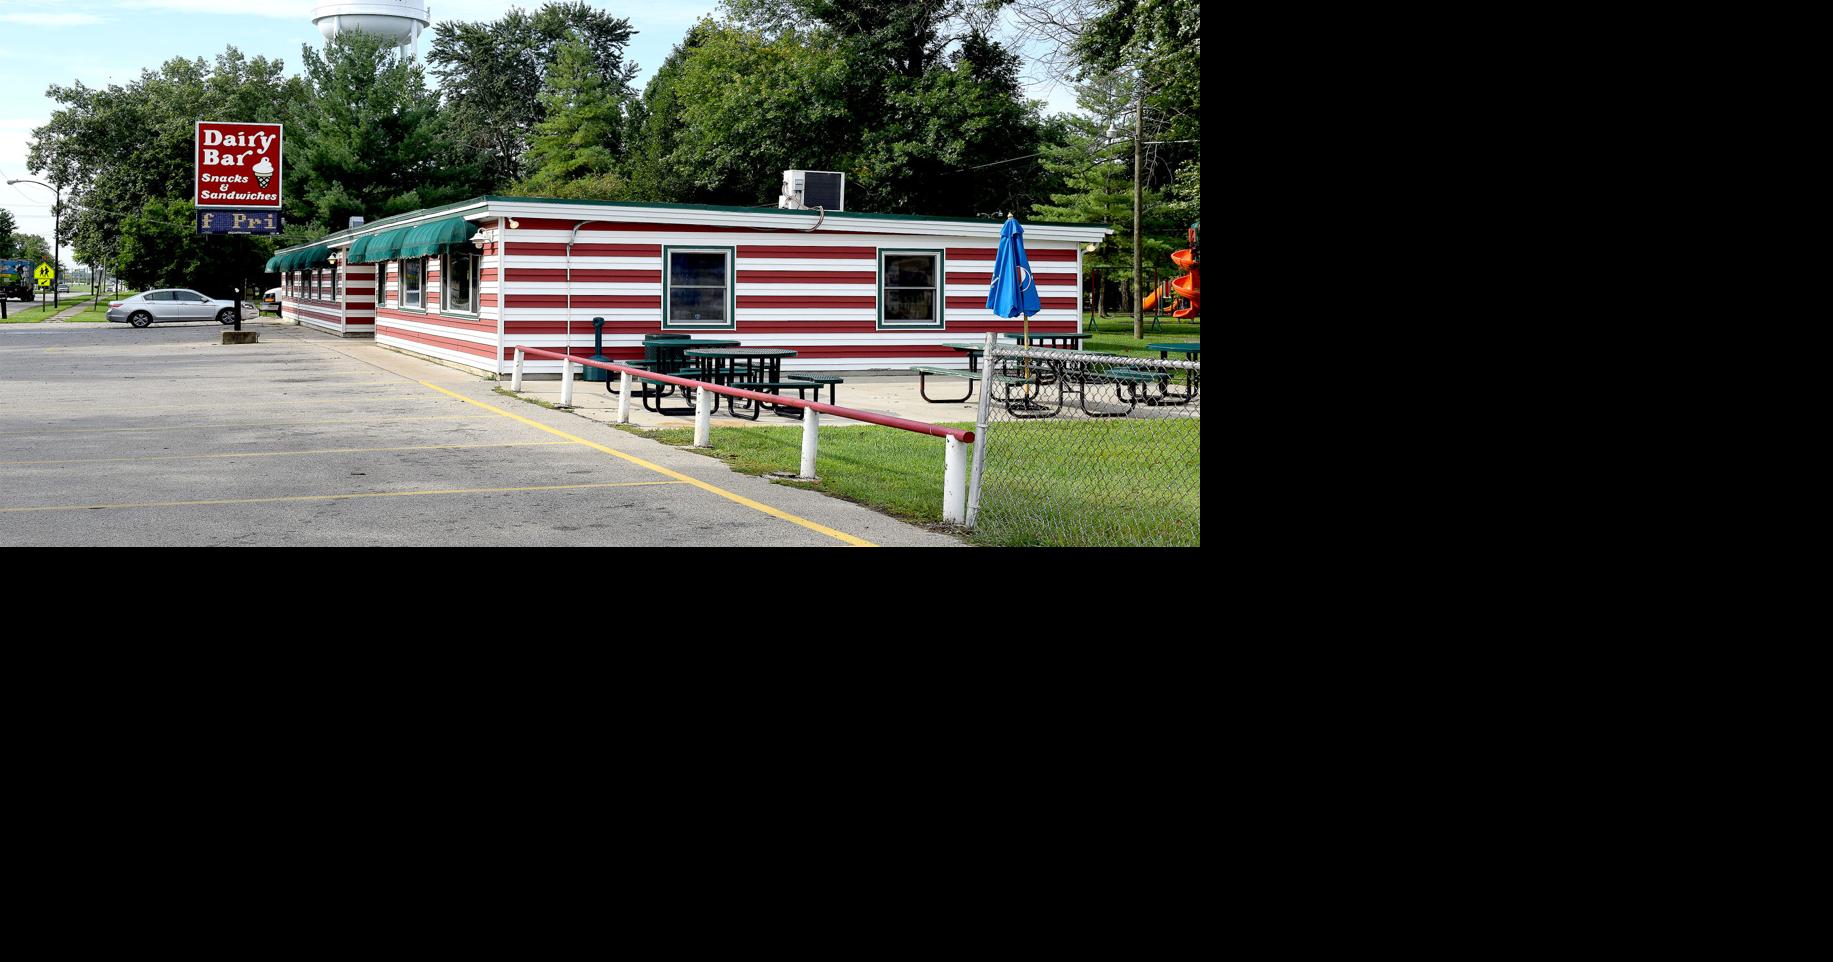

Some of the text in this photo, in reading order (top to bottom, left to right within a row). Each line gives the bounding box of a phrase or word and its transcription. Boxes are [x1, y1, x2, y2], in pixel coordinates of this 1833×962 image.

[203, 129, 277, 154] Dairy
[203, 148, 253, 166] Bar
[201, 173, 249, 183] Snacks
[219, 183, 229, 191] &
[200, 190, 278, 200] Sandwiches
[201, 213, 277, 229] f Pri
